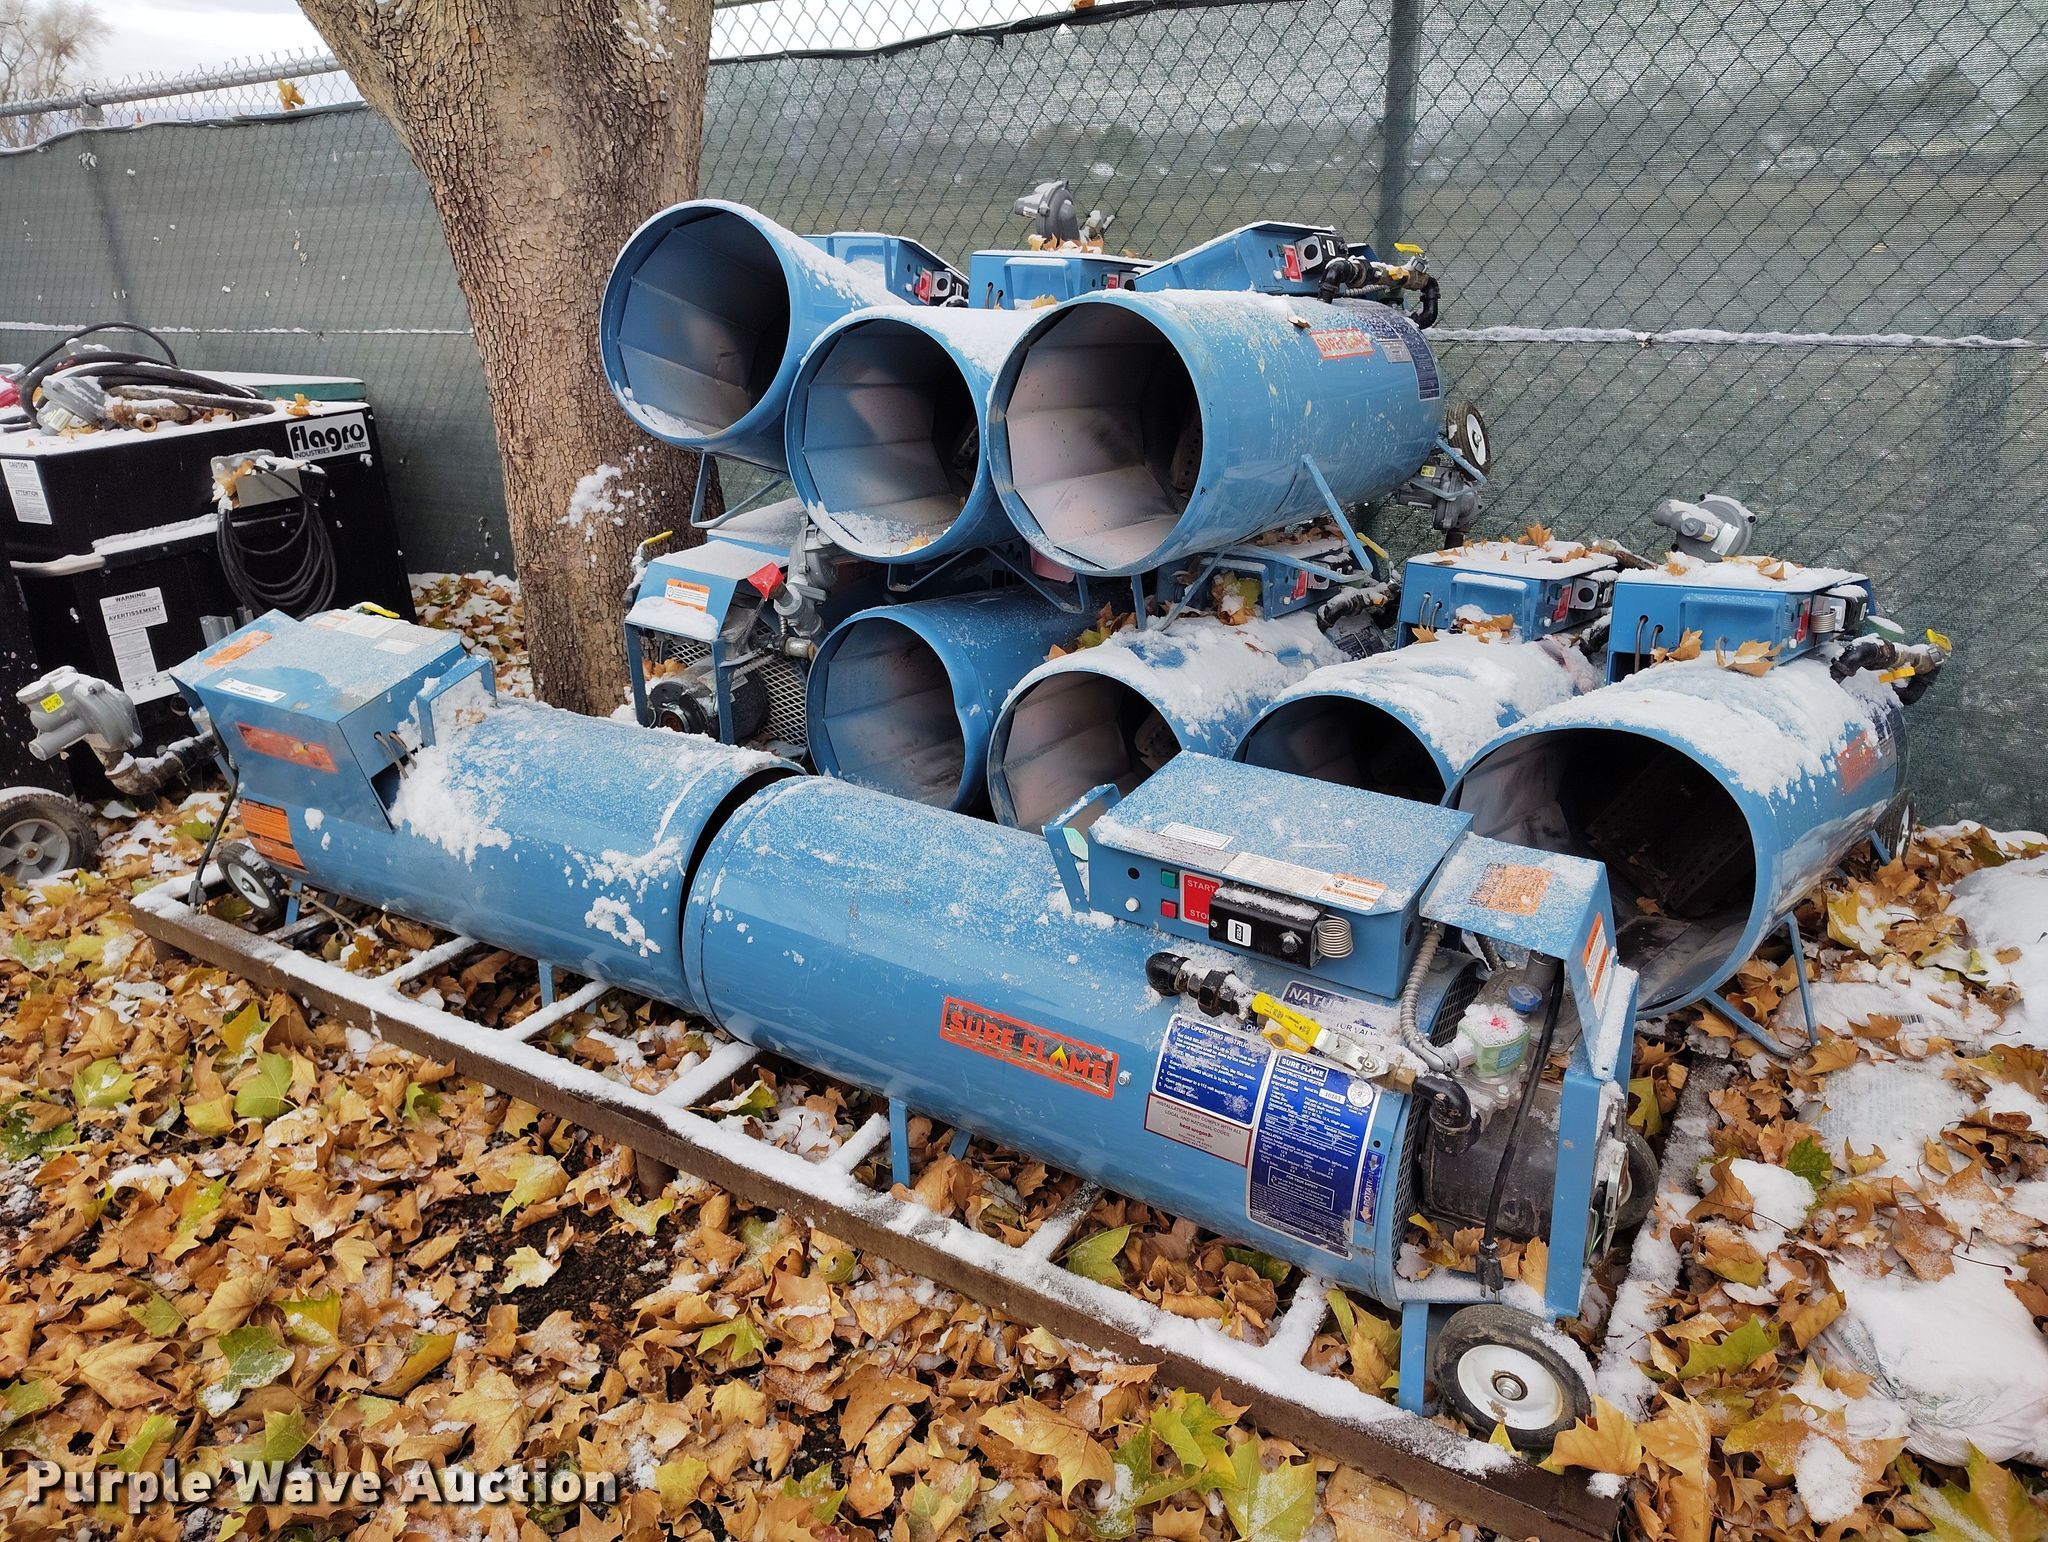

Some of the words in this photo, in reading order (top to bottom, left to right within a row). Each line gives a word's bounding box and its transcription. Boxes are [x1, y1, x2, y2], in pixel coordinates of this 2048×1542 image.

[290, 424, 365, 452] flagro
[294, 447, 330, 458] INDUSTRIES
[343, 442, 367, 450] LIMITED
[115, 591, 147, 603] WARNING
[108, 605, 161, 622] AVERTISSEMENT
[1187, 880, 1216, 893] START
[1190, 909, 1207, 920] STO
[1190, 1024, 1224, 1041] OPERATING
[950, 1008, 1016, 1052] SURE
[1021, 1033, 1107, 1084] FLAME
[1280, 1057, 1302, 1070] SURE
[1301, 1064, 1324, 1077] FLAME
[1272, 1073, 1286, 1082] Model
[1274, 1067, 1307, 1081] CONSTRUCTION
[1307, 1078, 1324, 1087] HEATER
[1156, 1100, 1186, 1114] INSTALLATION
[1187, 1111, 1199, 1119] MUST
[1200, 1116, 1219, 1126] COMPLY
[1220, 1123, 1232, 1131] WITH
[1164, 1109, 1179, 1118] LOCAL
[1190, 1119, 1212, 1130] NATIONAL
[1363, 1170, 1375, 1208] ROTATION
